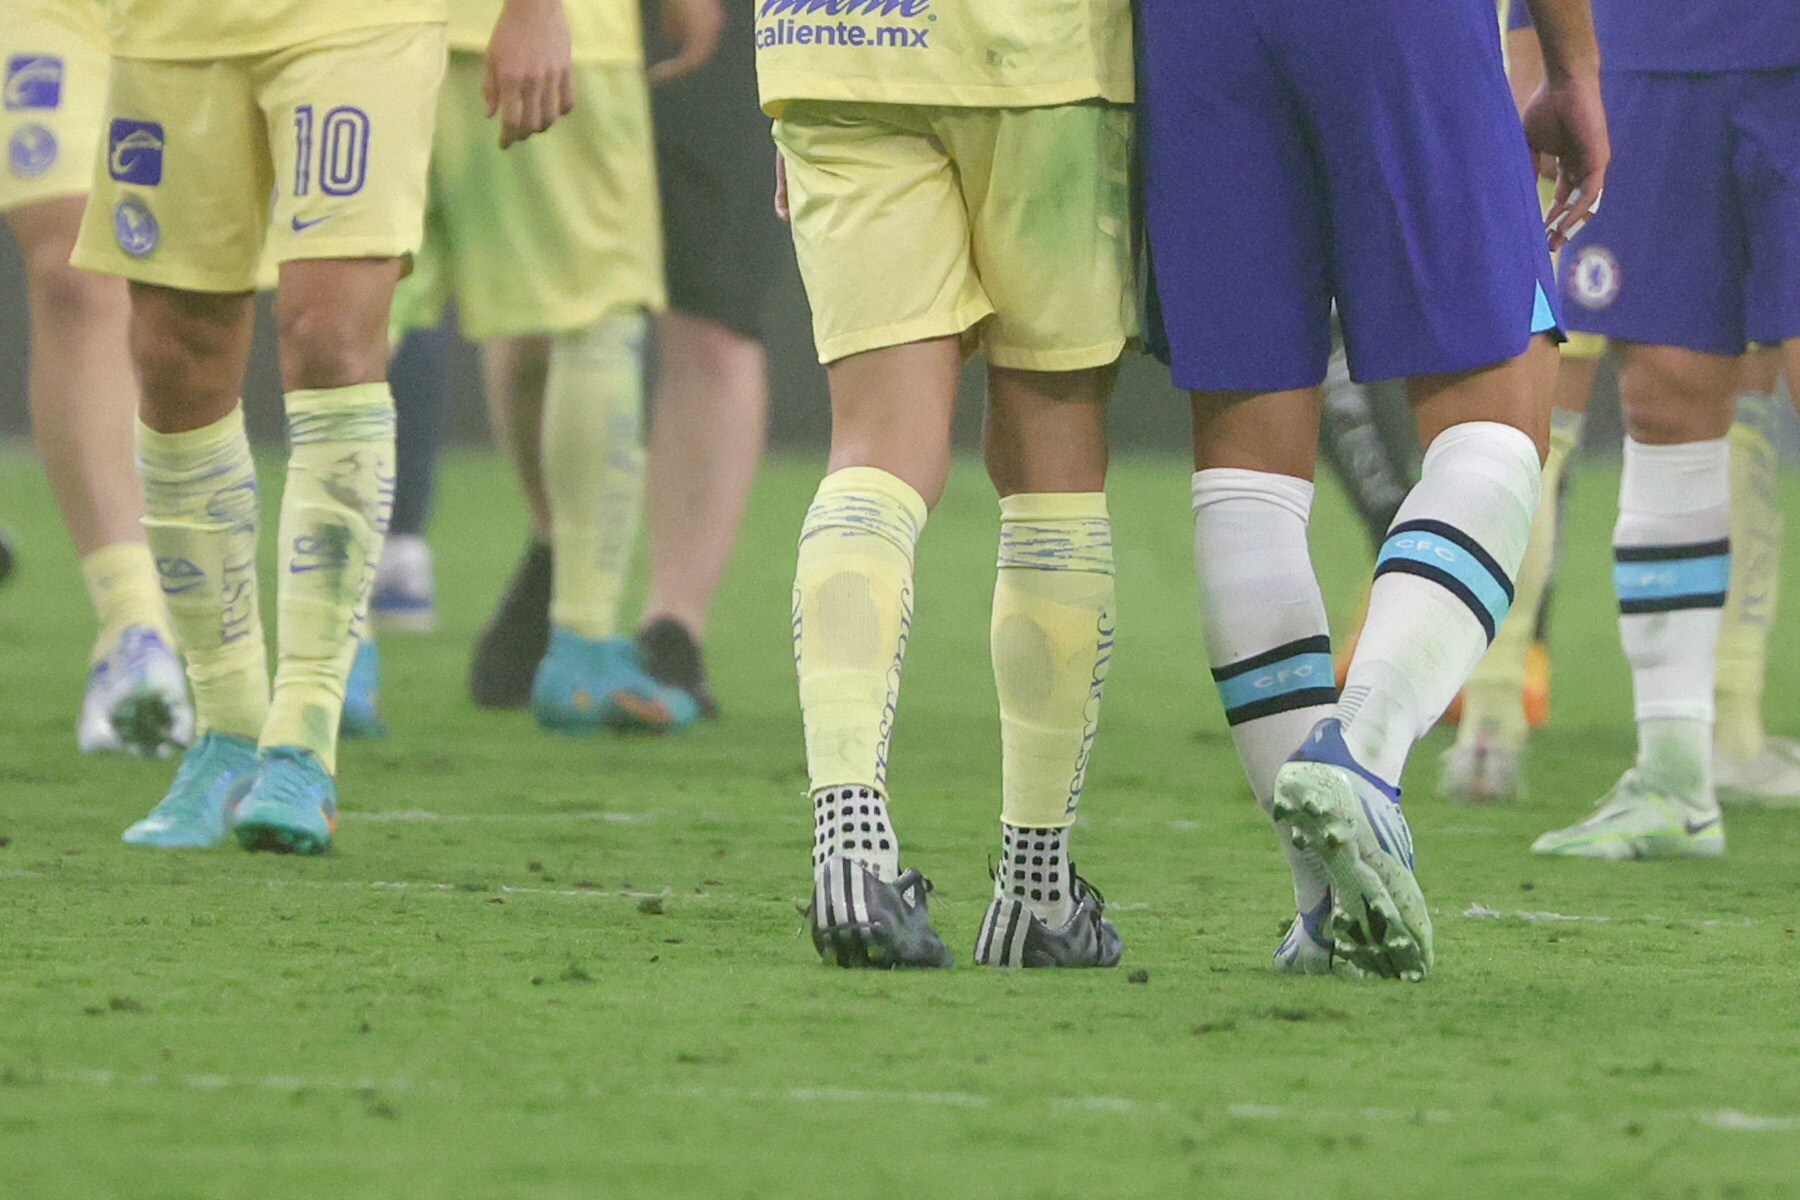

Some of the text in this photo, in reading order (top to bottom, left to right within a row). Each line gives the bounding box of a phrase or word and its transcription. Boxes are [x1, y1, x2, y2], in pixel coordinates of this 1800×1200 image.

[292, 105, 371, 197] 10
[1394, 538, 1457, 564] CFC
[1253, 663, 1314, 689] CFC
